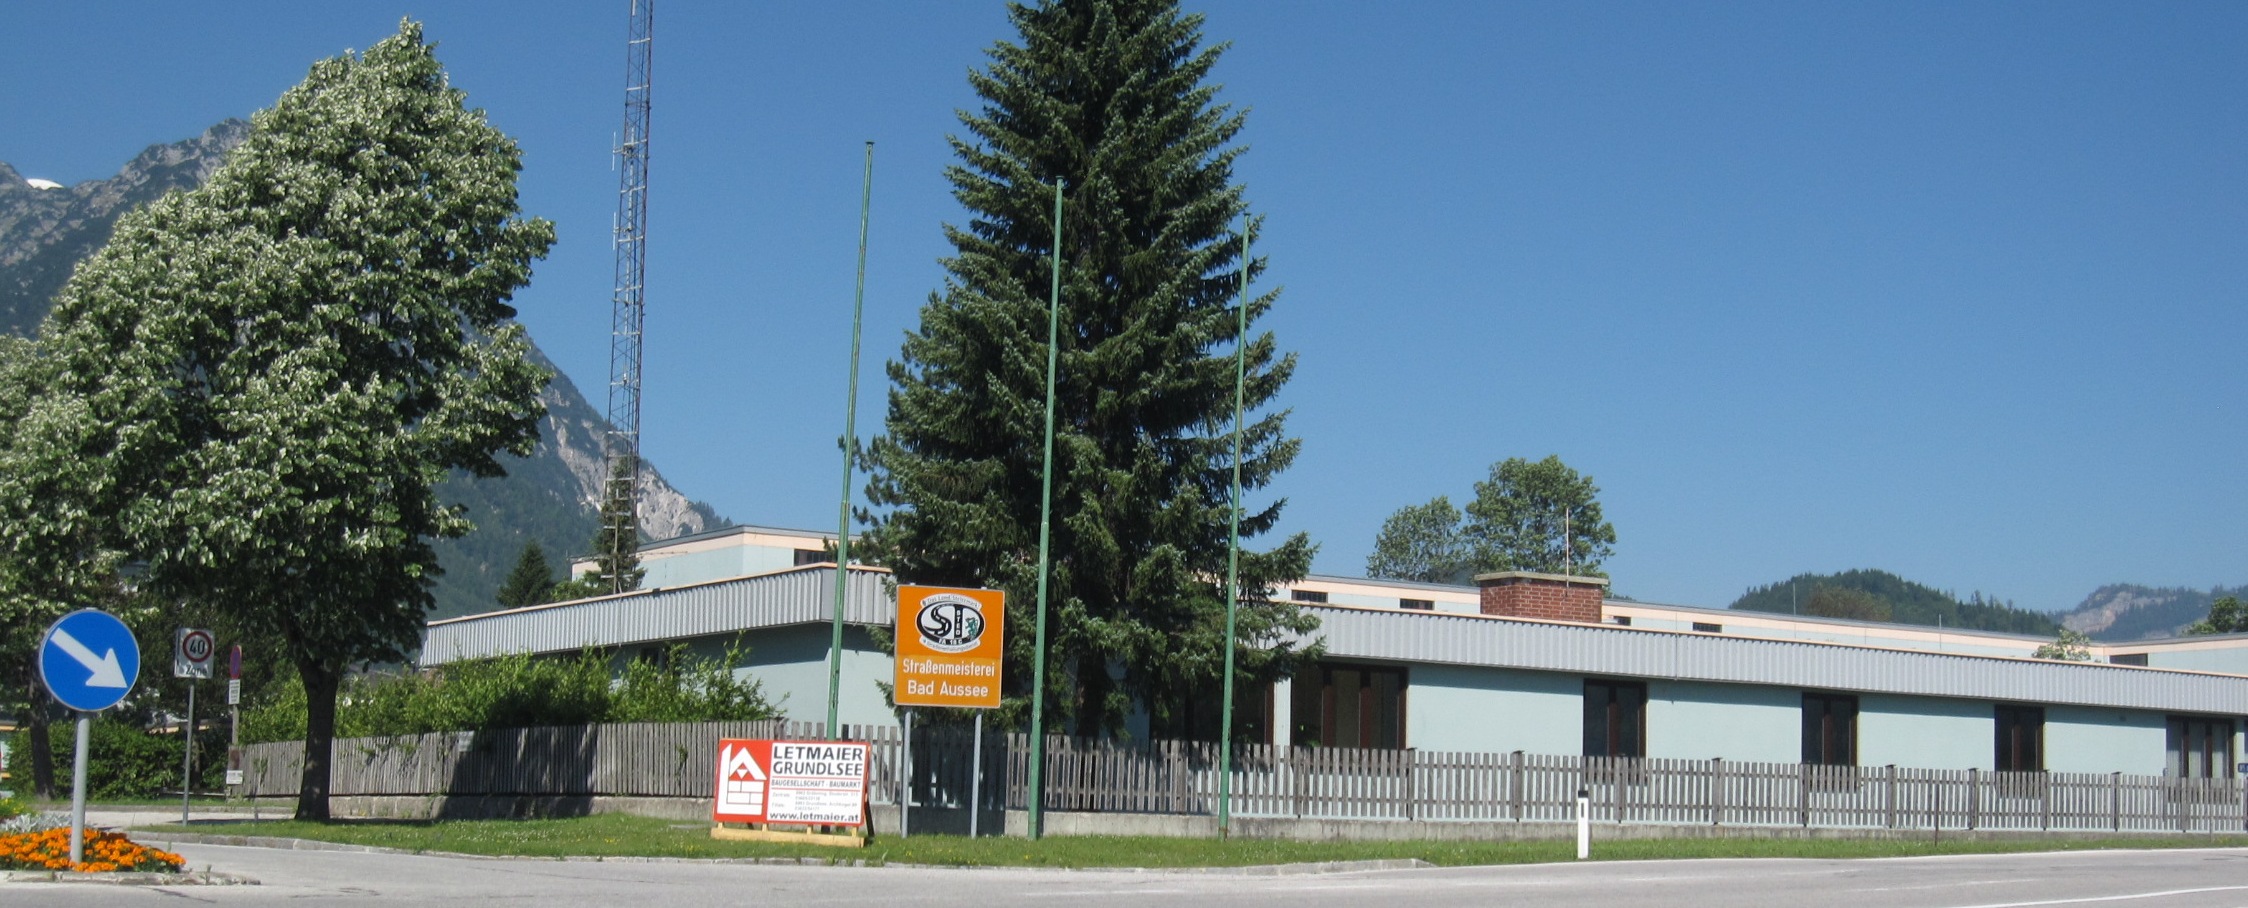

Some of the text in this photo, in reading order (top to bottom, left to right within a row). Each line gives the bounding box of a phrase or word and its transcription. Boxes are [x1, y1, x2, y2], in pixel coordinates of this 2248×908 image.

[189, 640, 205, 654] 40
[903, 658, 995, 677] Straßenmeisterei
[907, 679, 989, 697] Bad Aussee
[773, 746, 863, 761] LETMAIER
[773, 761, 863, 776] GRUNDLSEE
[771, 779, 861, 788] BAUGESELLSCHAFT BAUMARKT
[769, 812, 859, 822] www.letmaier.at
